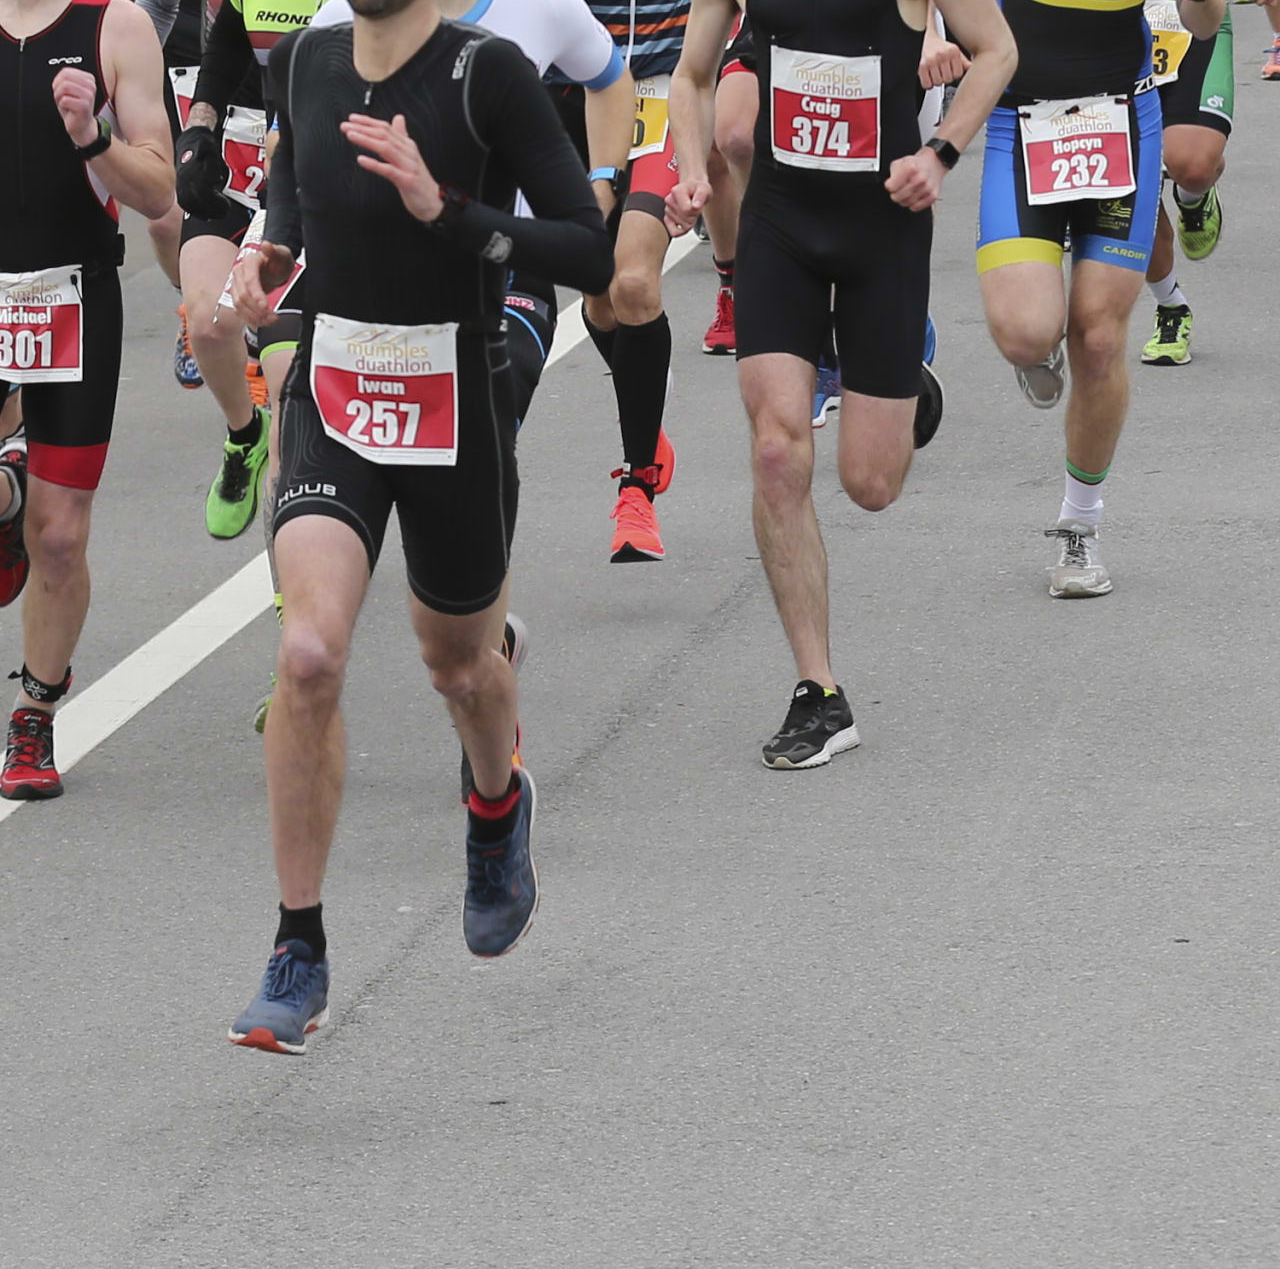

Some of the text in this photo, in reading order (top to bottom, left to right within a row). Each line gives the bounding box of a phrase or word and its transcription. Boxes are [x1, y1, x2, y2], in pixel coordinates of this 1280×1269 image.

[255, 10, 313, 25] RHOND
[796, 65, 861, 86] mumbles
[801, 80, 863, 98] duathlon
[801, 97, 841, 120] Craig
[791, 118, 850, 156] 374
[1057, 119, 1113, 137] duathlon
[1052, 137, 1103, 155] Hopcyn
[1051, 154, 1109, 191] 232
[346, 337, 430, 359] mumbles
[355, 354, 432, 373] duathlon
[357, 375, 405, 396] Iwan
[346, 400, 421, 446] 257
